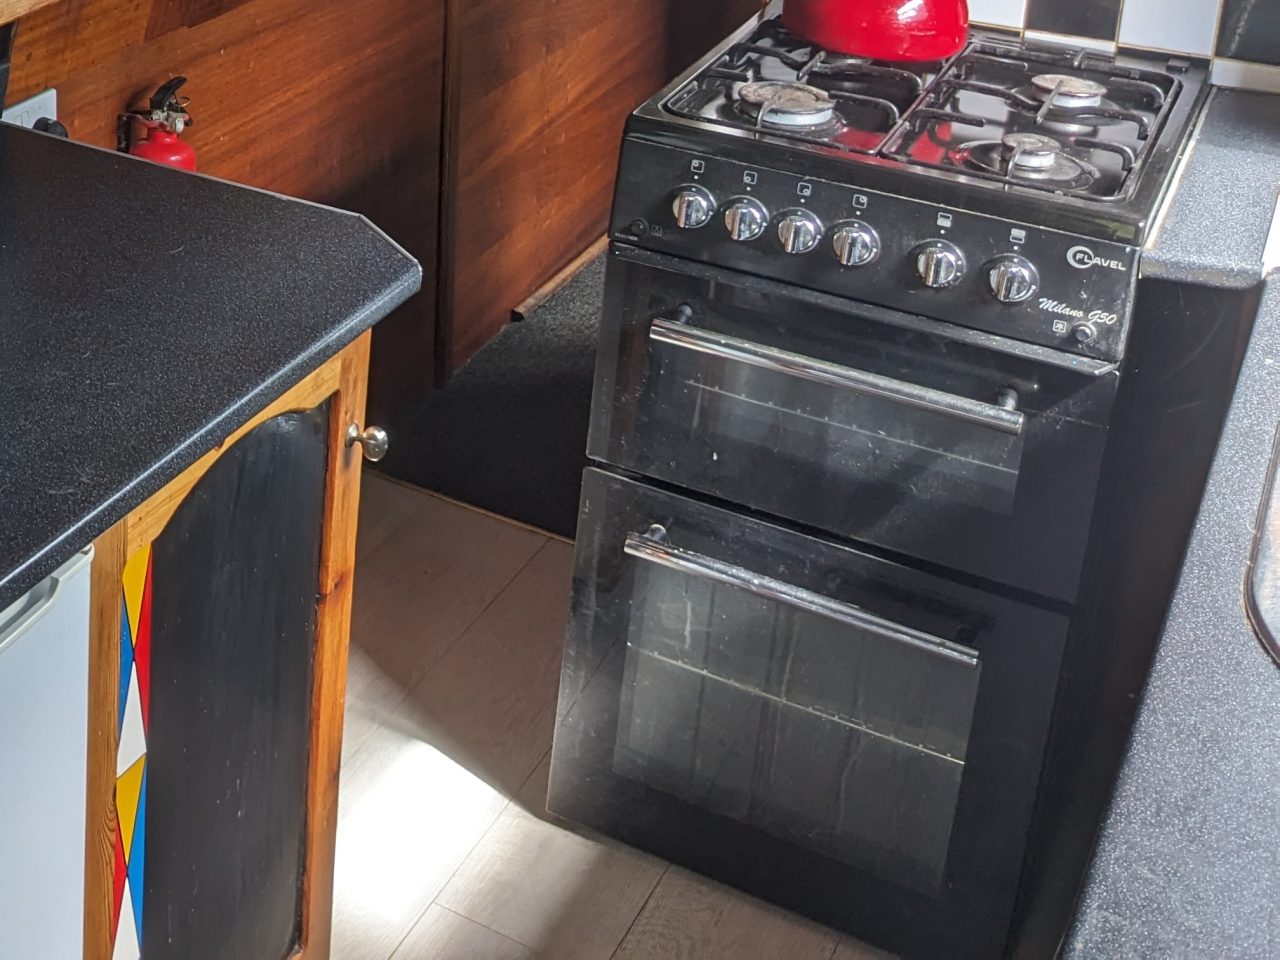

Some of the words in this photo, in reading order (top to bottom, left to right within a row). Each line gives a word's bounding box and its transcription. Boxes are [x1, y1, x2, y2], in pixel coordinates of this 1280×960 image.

[1075, 253, 1126, 271] FLAVEL
[1038, 298, 1084, 318] Milano
[1088, 310, 1117, 325] G50
